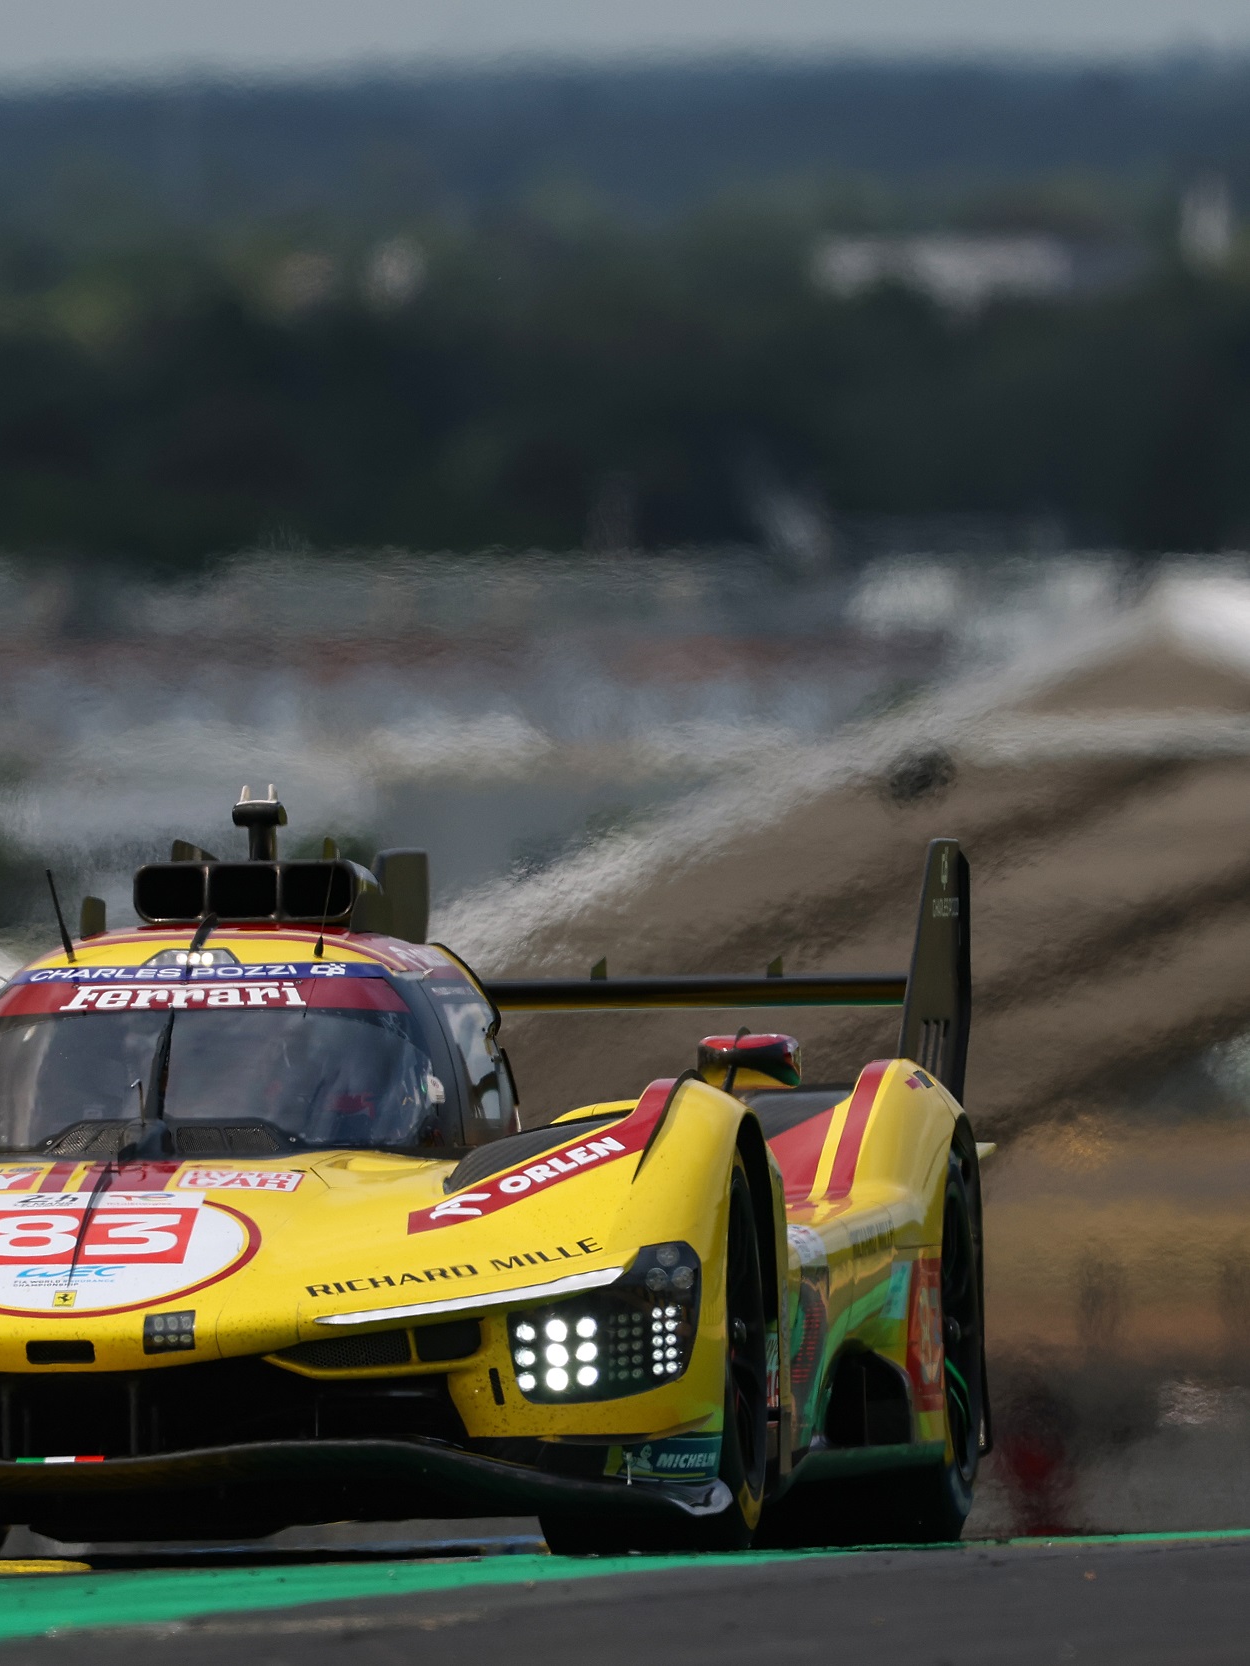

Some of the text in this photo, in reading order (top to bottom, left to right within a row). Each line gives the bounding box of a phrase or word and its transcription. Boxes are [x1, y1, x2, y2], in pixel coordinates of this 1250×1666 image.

[30, 966, 182, 982] CHARLES
[190, 964, 298, 978] POZZI
[59, 982, 307, 1011] Ferrari
[498, 1136, 626, 1194] ORLEN
[188, 1176, 290, 1189] CAR
[192, 1170, 294, 1180] HYPER
[16, 1265, 127, 1278] WEC
[304, 1236, 604, 1299] RICHARD MILLE
